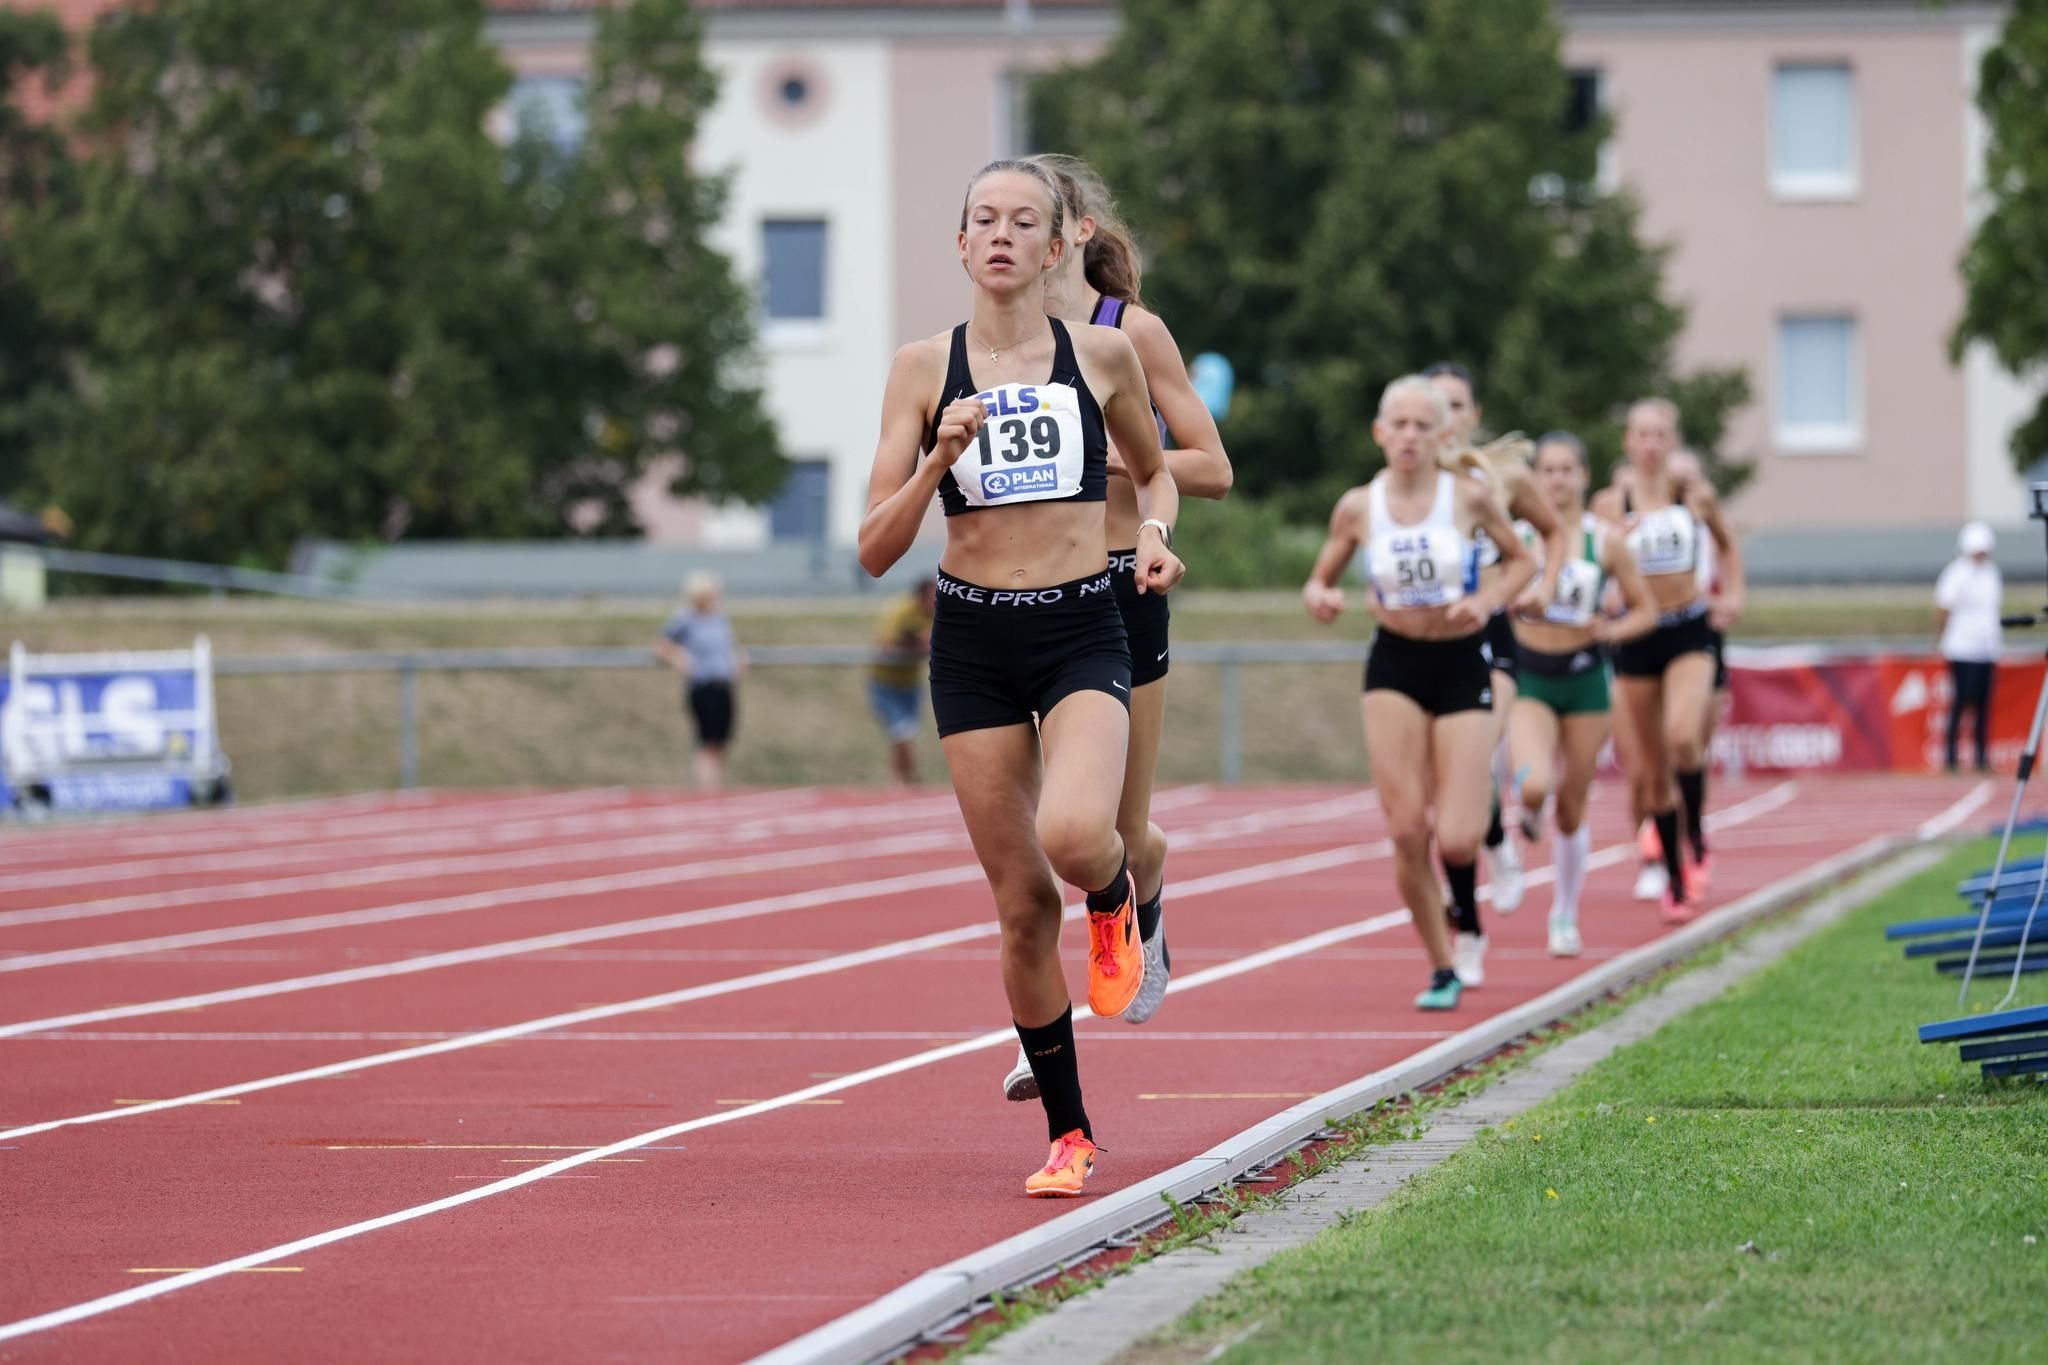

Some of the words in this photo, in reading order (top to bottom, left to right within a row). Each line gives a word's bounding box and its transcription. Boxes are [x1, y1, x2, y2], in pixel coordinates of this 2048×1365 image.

[976, 415, 1061, 466] 139
[1012, 468, 1054, 485] PLAN
[1013, 482, 1055, 491] INTERNATIONAL
[1108, 554, 1137, 573] PR
[1397, 557, 1435, 587] 50
[990, 588, 1063, 607] PRO
[1034, 1044, 1063, 1057] cep
